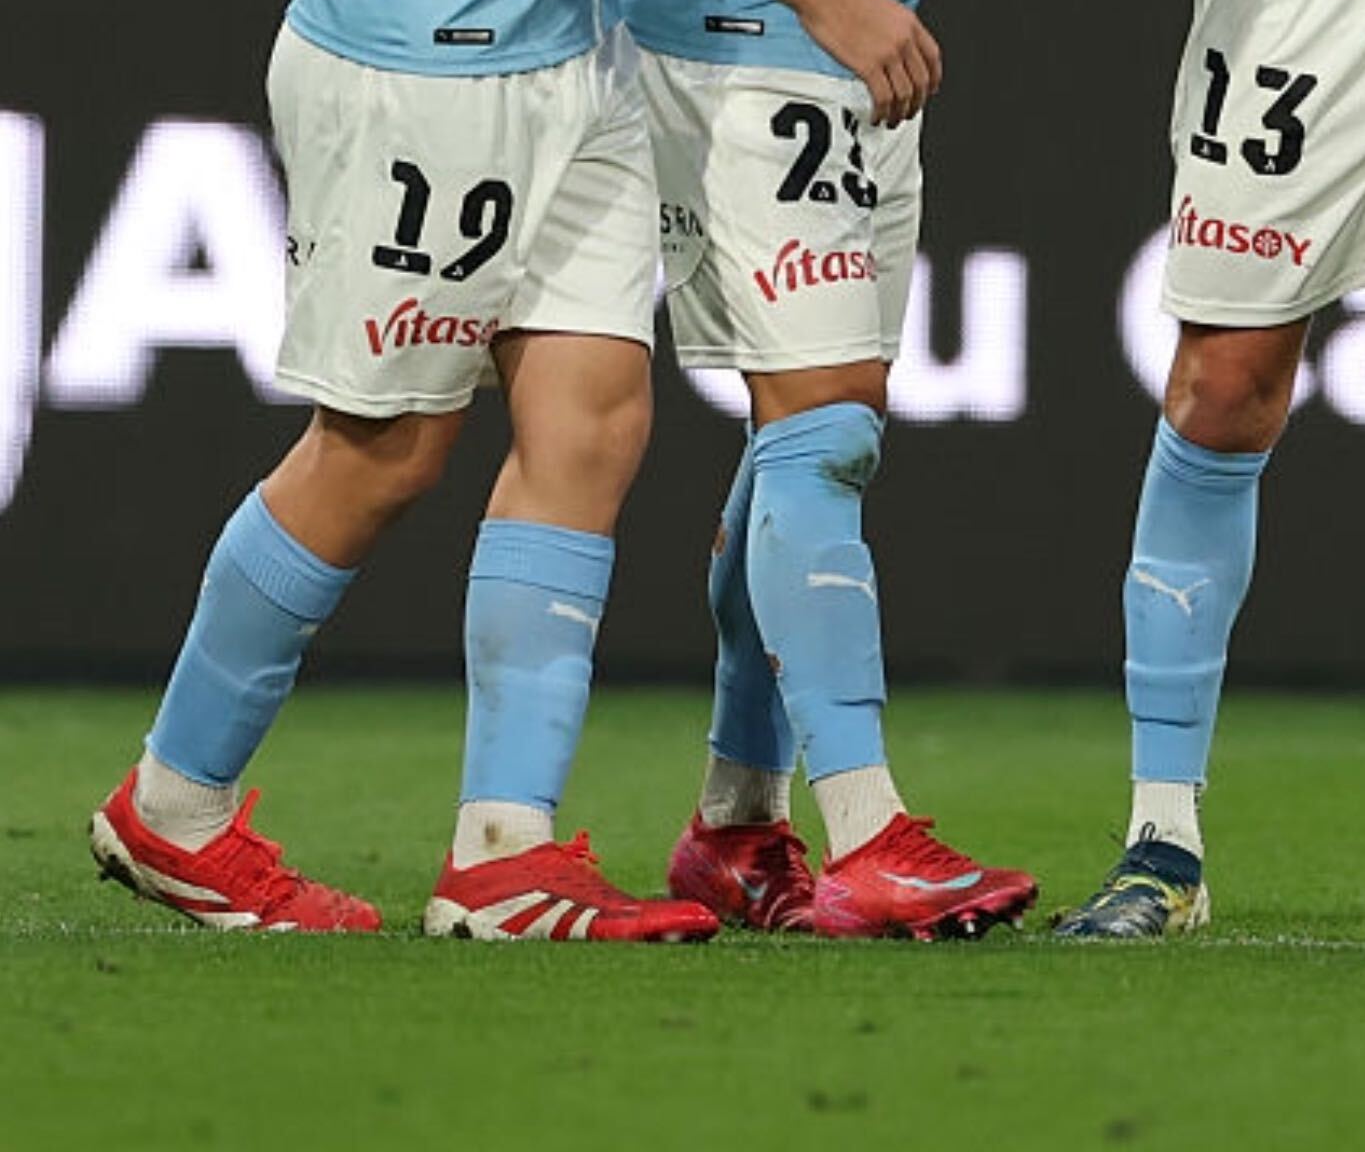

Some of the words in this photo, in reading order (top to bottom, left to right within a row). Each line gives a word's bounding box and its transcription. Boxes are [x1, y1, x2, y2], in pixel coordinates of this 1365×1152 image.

[1191, 48, 1318, 176] 13
[372, 160, 513, 282] 19
[754, 239, 878, 303] Vitas
[365, 297, 500, 356] Vitas
